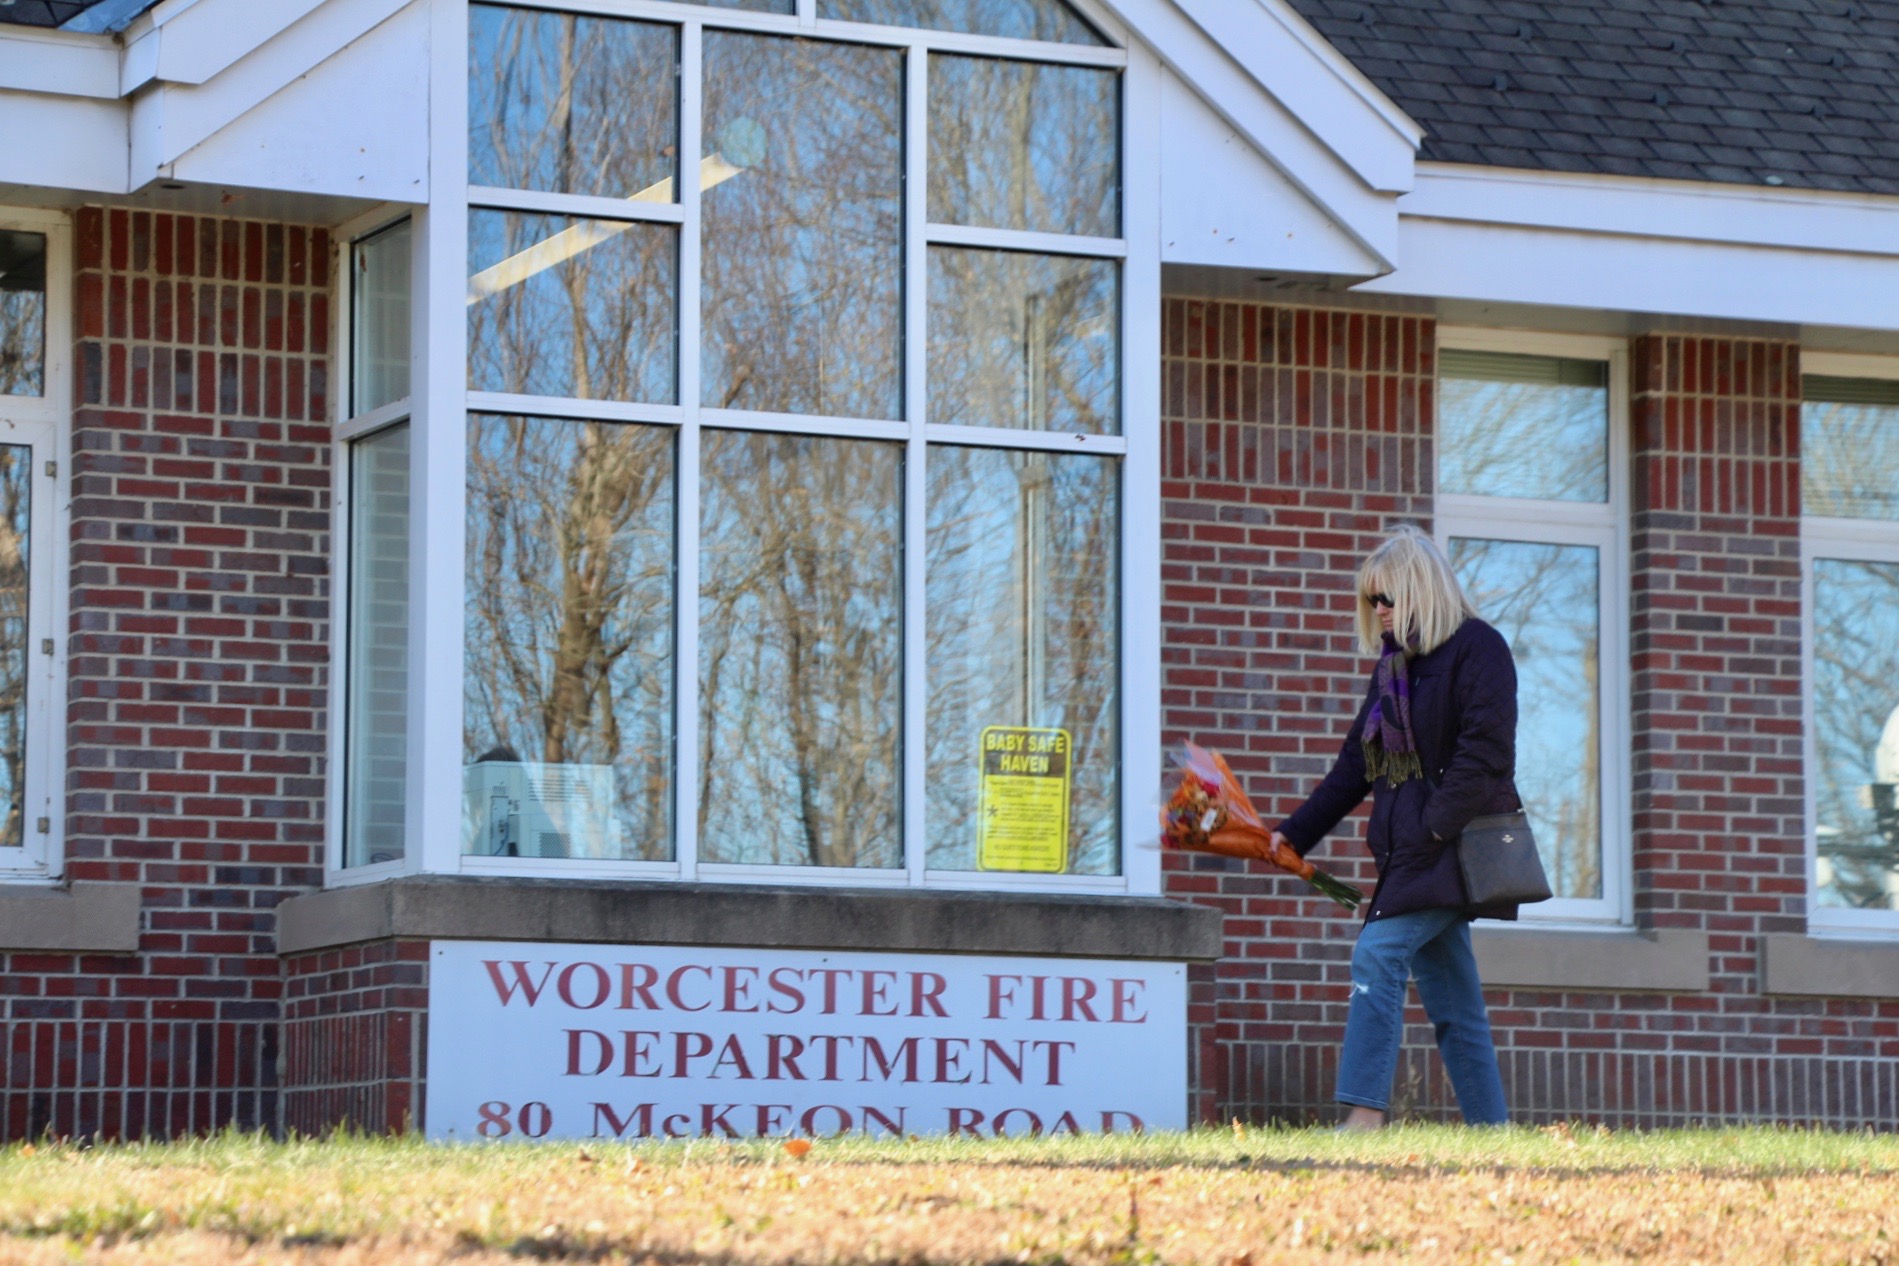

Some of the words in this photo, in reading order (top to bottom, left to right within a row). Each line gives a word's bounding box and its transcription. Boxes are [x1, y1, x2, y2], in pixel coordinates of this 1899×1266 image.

[986, 733, 1025, 751] BABY
[1028, 735, 1064, 753] SAFE
[1000, 754, 1049, 773] HAVEN
[481, 960, 952, 1018] WORCESTER
[981, 974, 1148, 1024] FIRE
[561, 1029, 1076, 1086] DEPARTMENT
[476, 1100, 553, 1138] 80
[587, 1102, 908, 1140] McKEON
[945, 1106, 1145, 1140] ROAD
